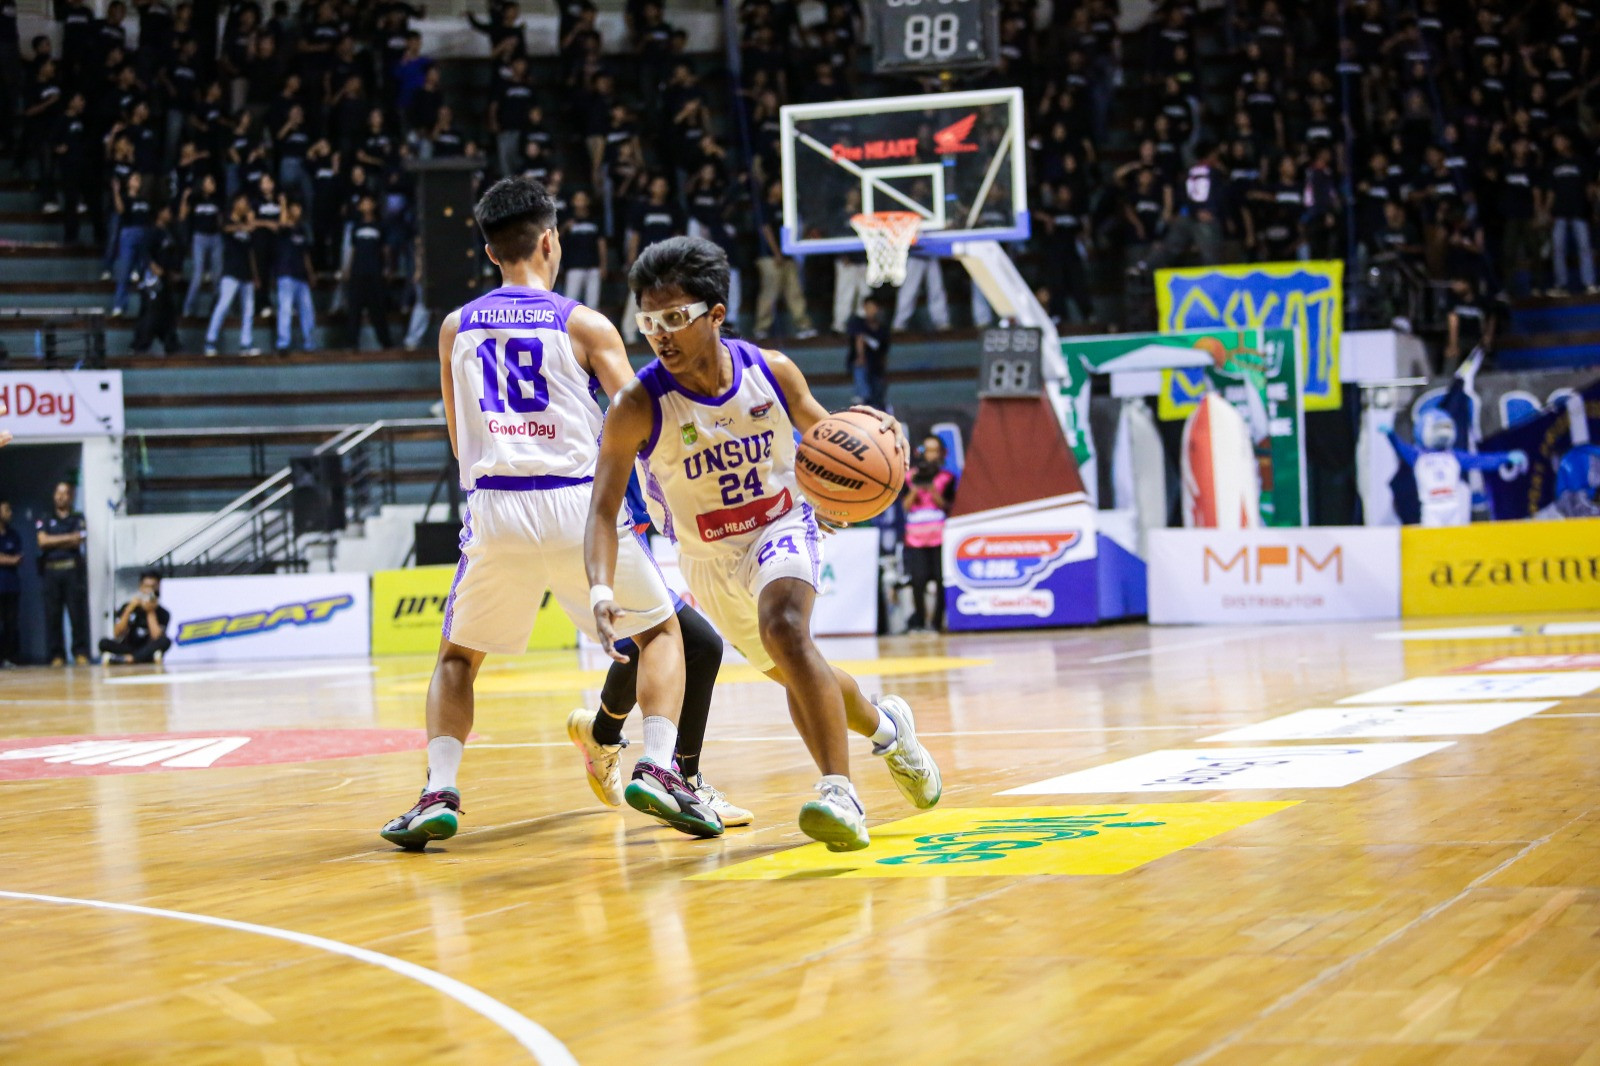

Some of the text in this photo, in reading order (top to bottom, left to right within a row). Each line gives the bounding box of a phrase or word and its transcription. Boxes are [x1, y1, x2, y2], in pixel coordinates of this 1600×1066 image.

[864, 138, 918, 160] HEART
[470, 309, 555, 324] ATHANASIUS
[476, 337, 550, 413] 18
[828, 430, 870, 462] DBL
[718, 467, 765, 506] 24
[704, 517, 757, 540] One HEART
[756, 535, 800, 567] 24
[1204, 545, 1343, 584] MPM
